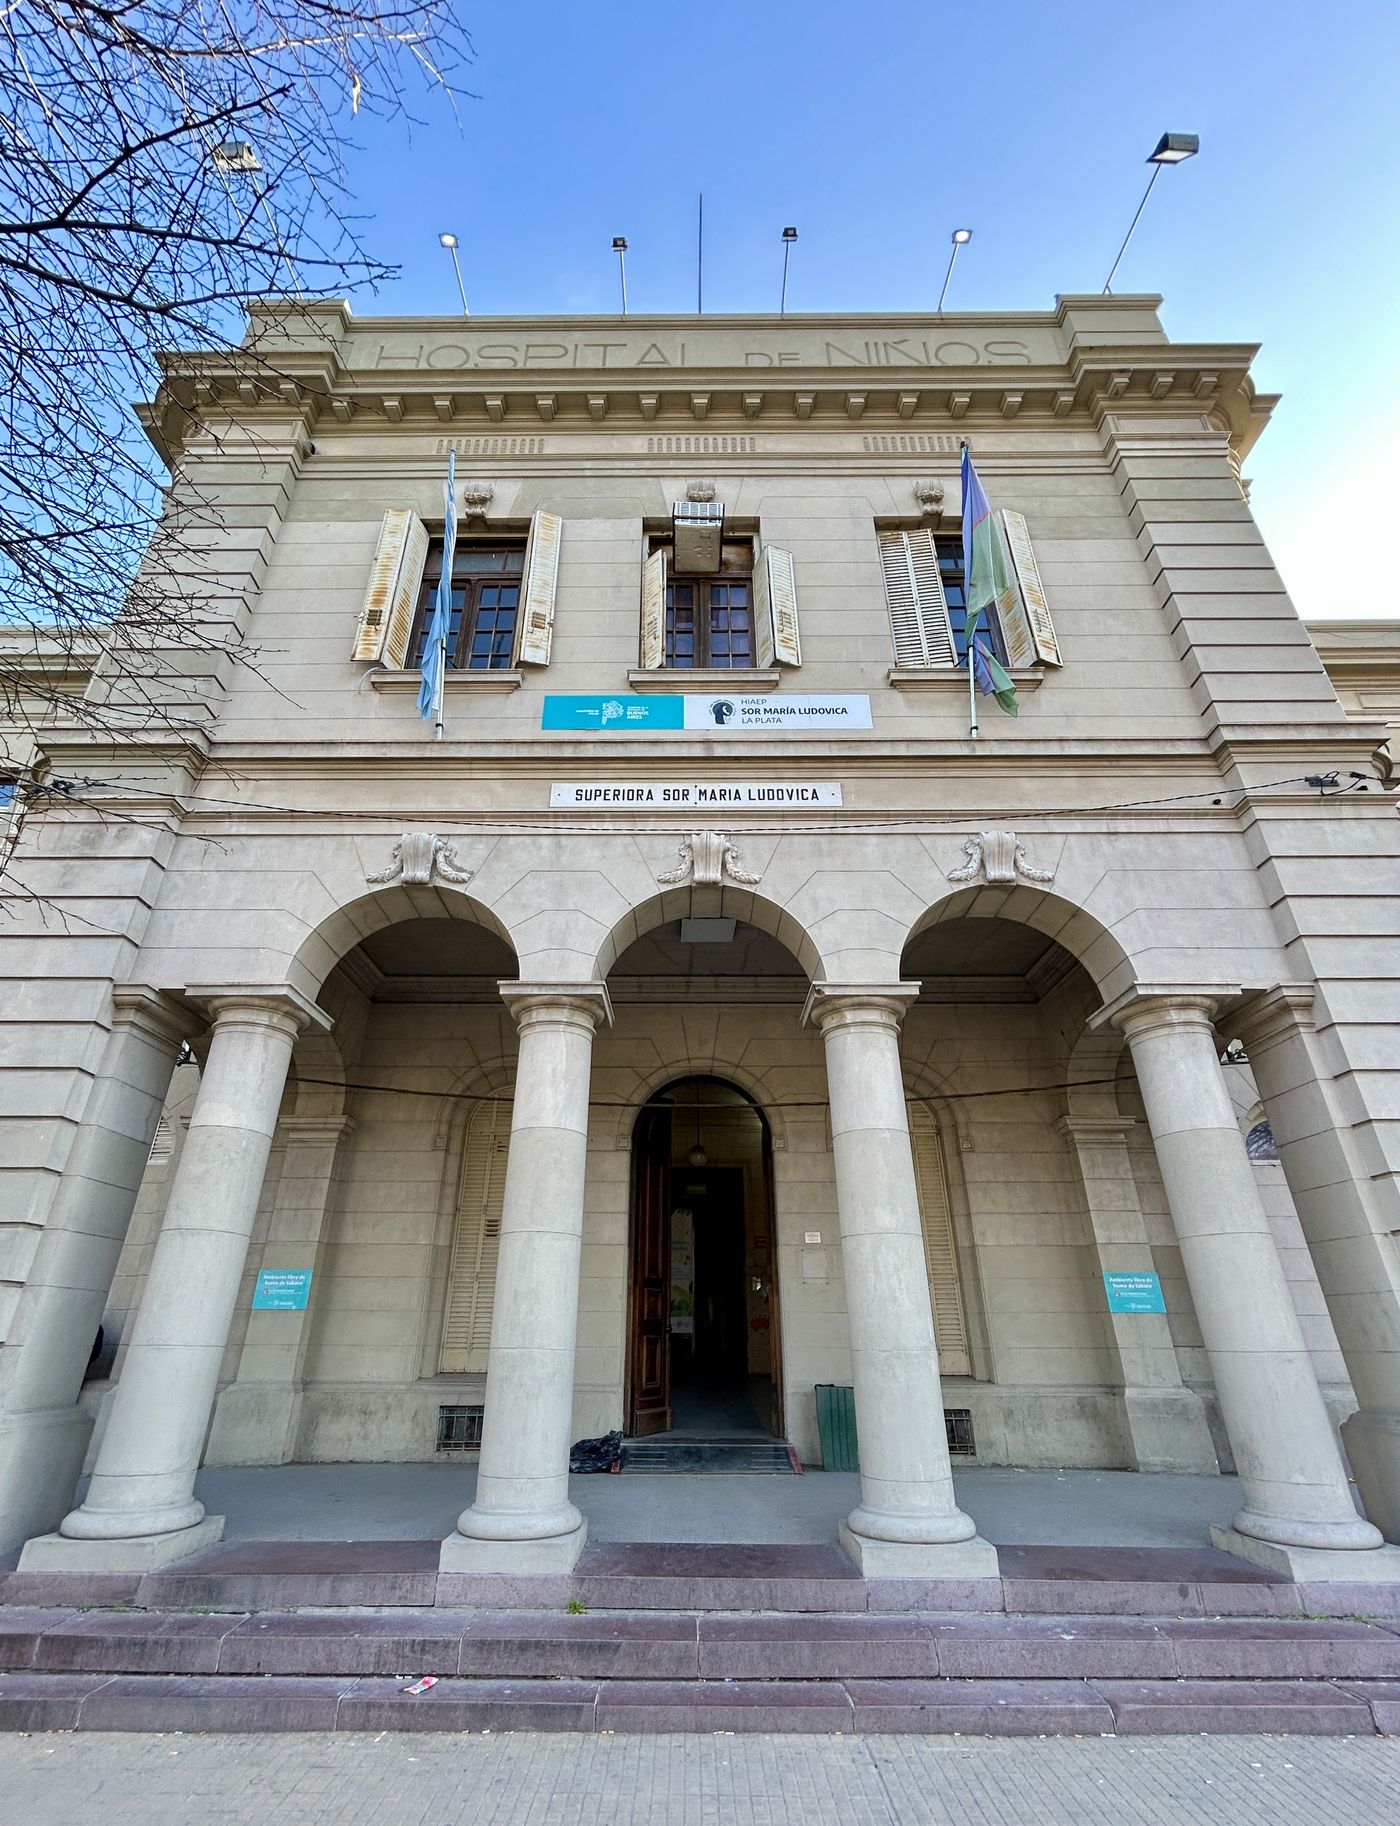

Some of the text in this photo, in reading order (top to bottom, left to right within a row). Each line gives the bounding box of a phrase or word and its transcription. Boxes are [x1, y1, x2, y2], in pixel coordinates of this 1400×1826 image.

[741, 707, 762, 715] SOR
[763, 705, 796, 715] MARÍA
[799, 707, 848, 715] LUDOVICA
[575, 788, 820, 801] SUPERIORA SOR MARIA LUDOVICA
